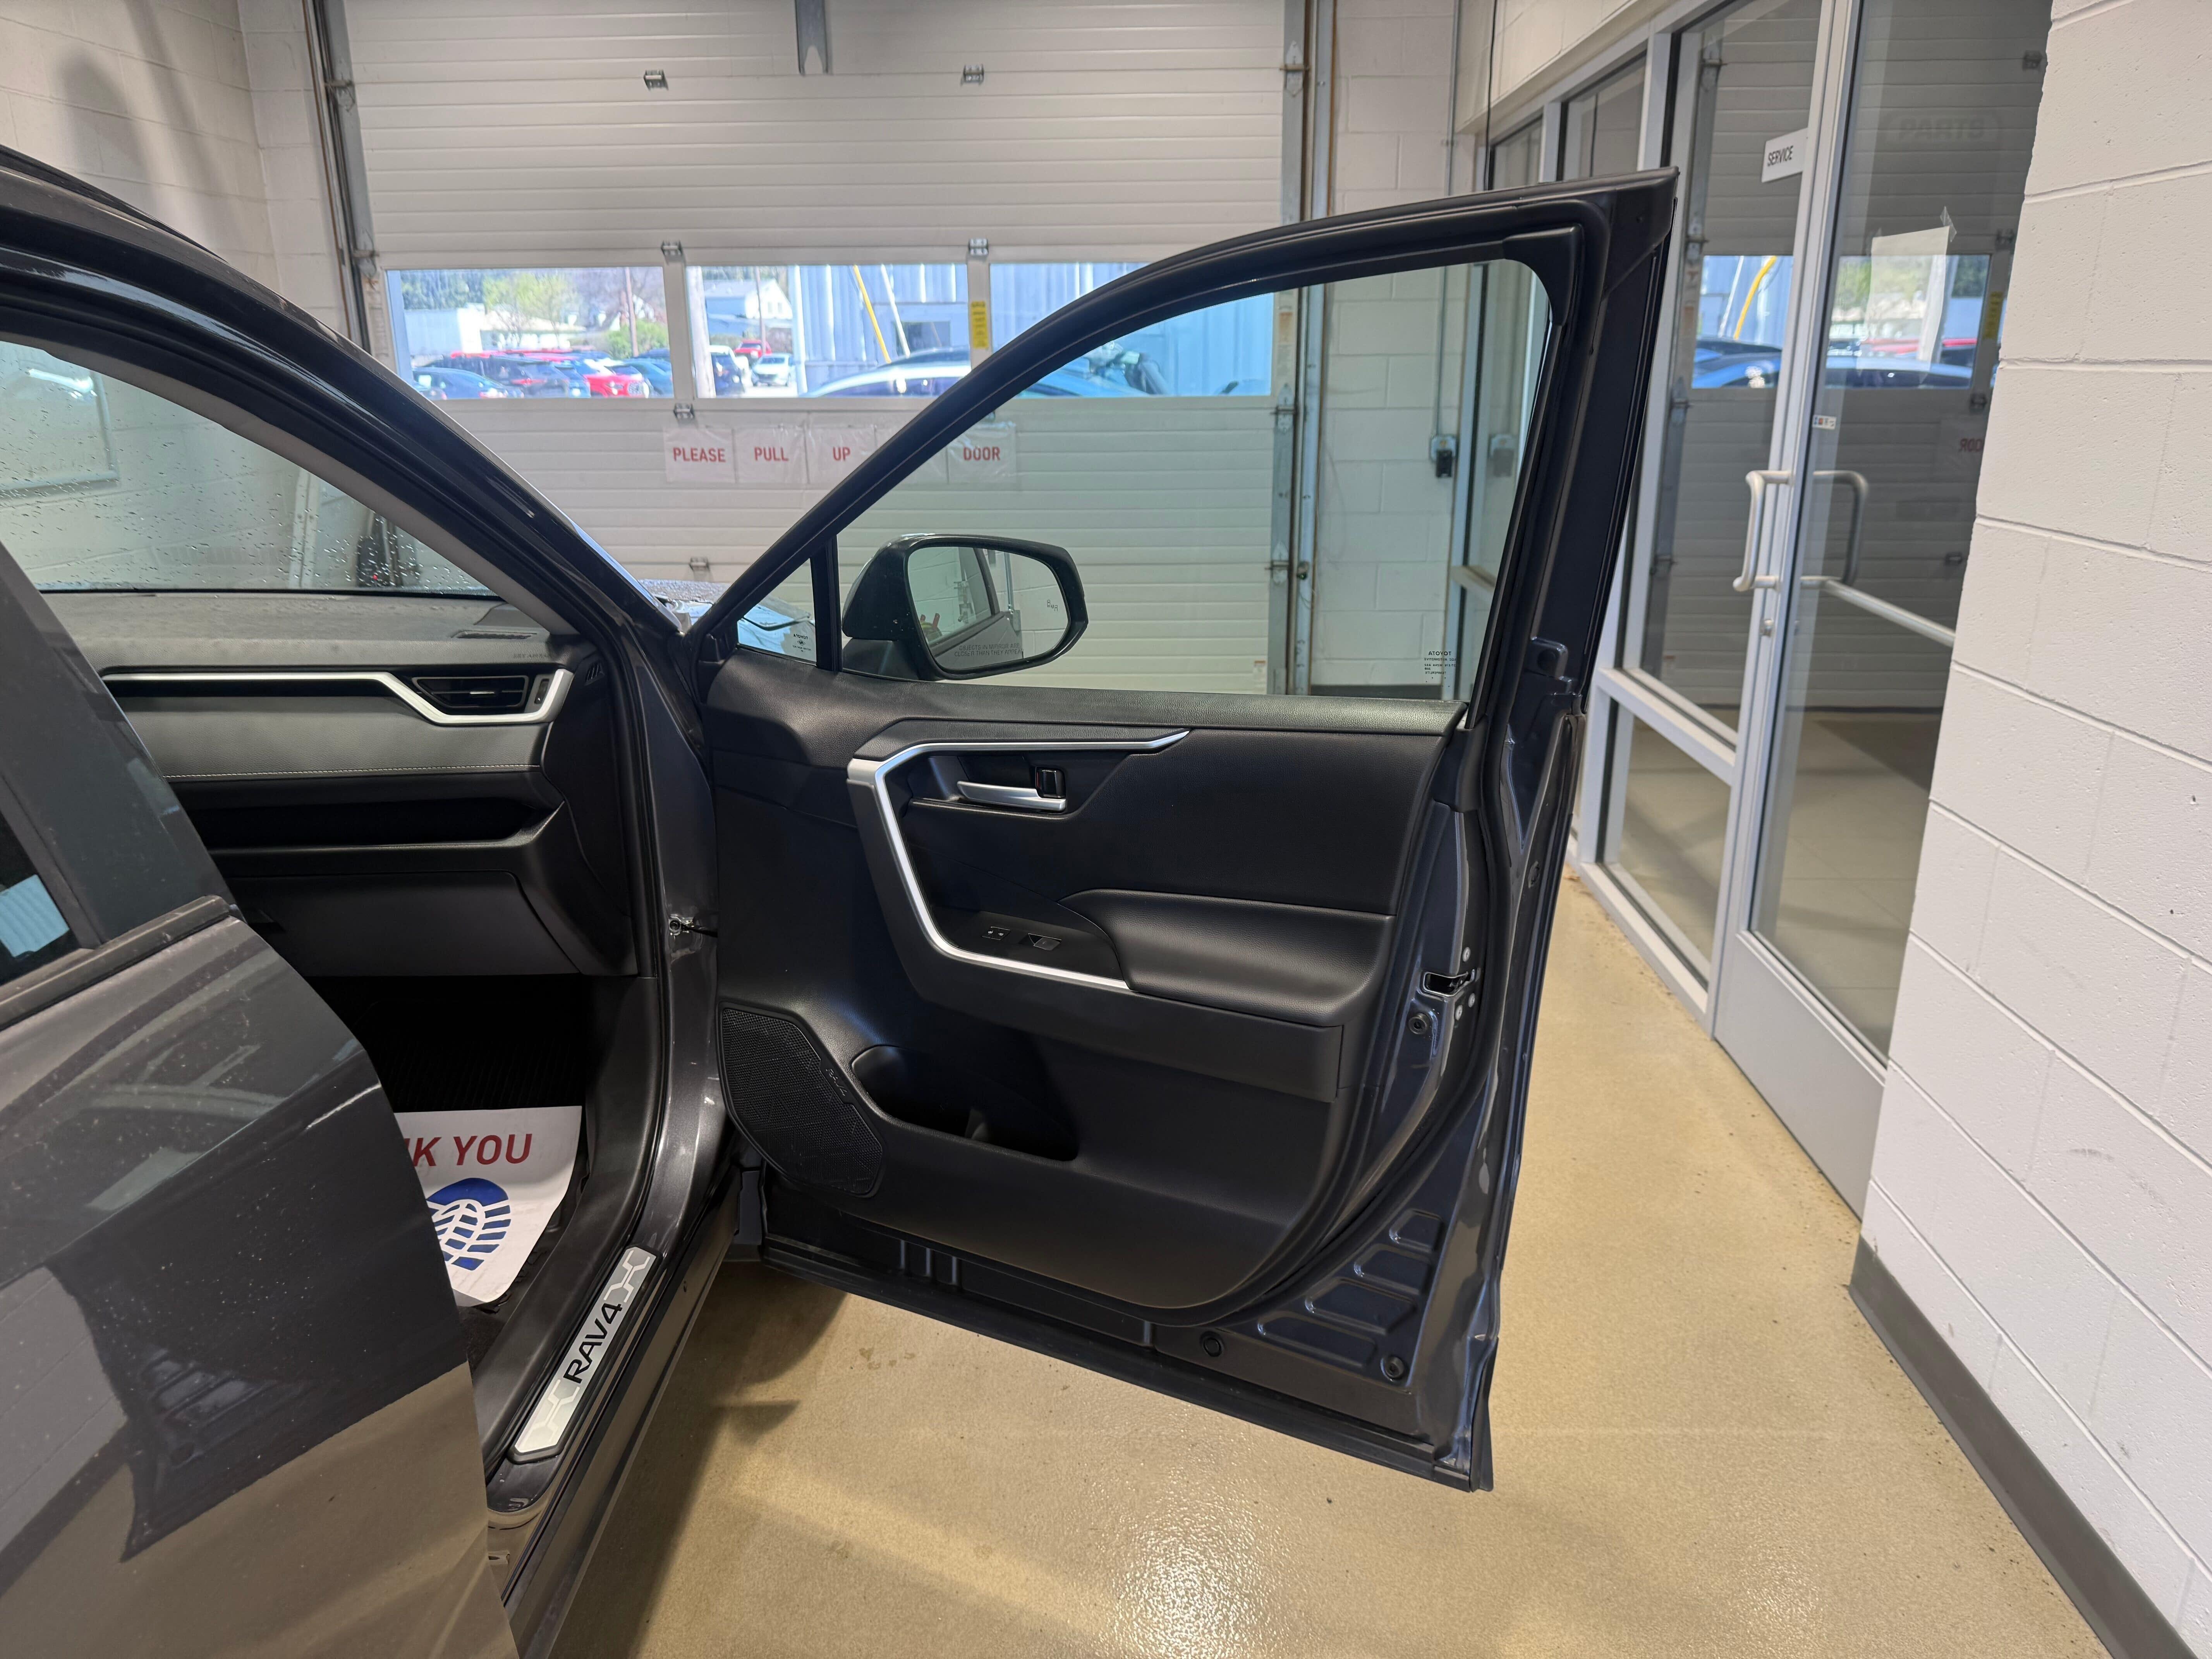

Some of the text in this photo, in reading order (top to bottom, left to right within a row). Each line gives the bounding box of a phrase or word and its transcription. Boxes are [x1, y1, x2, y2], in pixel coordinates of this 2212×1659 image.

[1767, 145, 1793, 167] SERVICE
[673, 447, 1000, 462] PLEASE PULL UP DOOR
[825, 1068, 848, 1096] RAV4
[453, 1133, 532, 1165] YOU
[563, 1302, 622, 1384] RAV4
